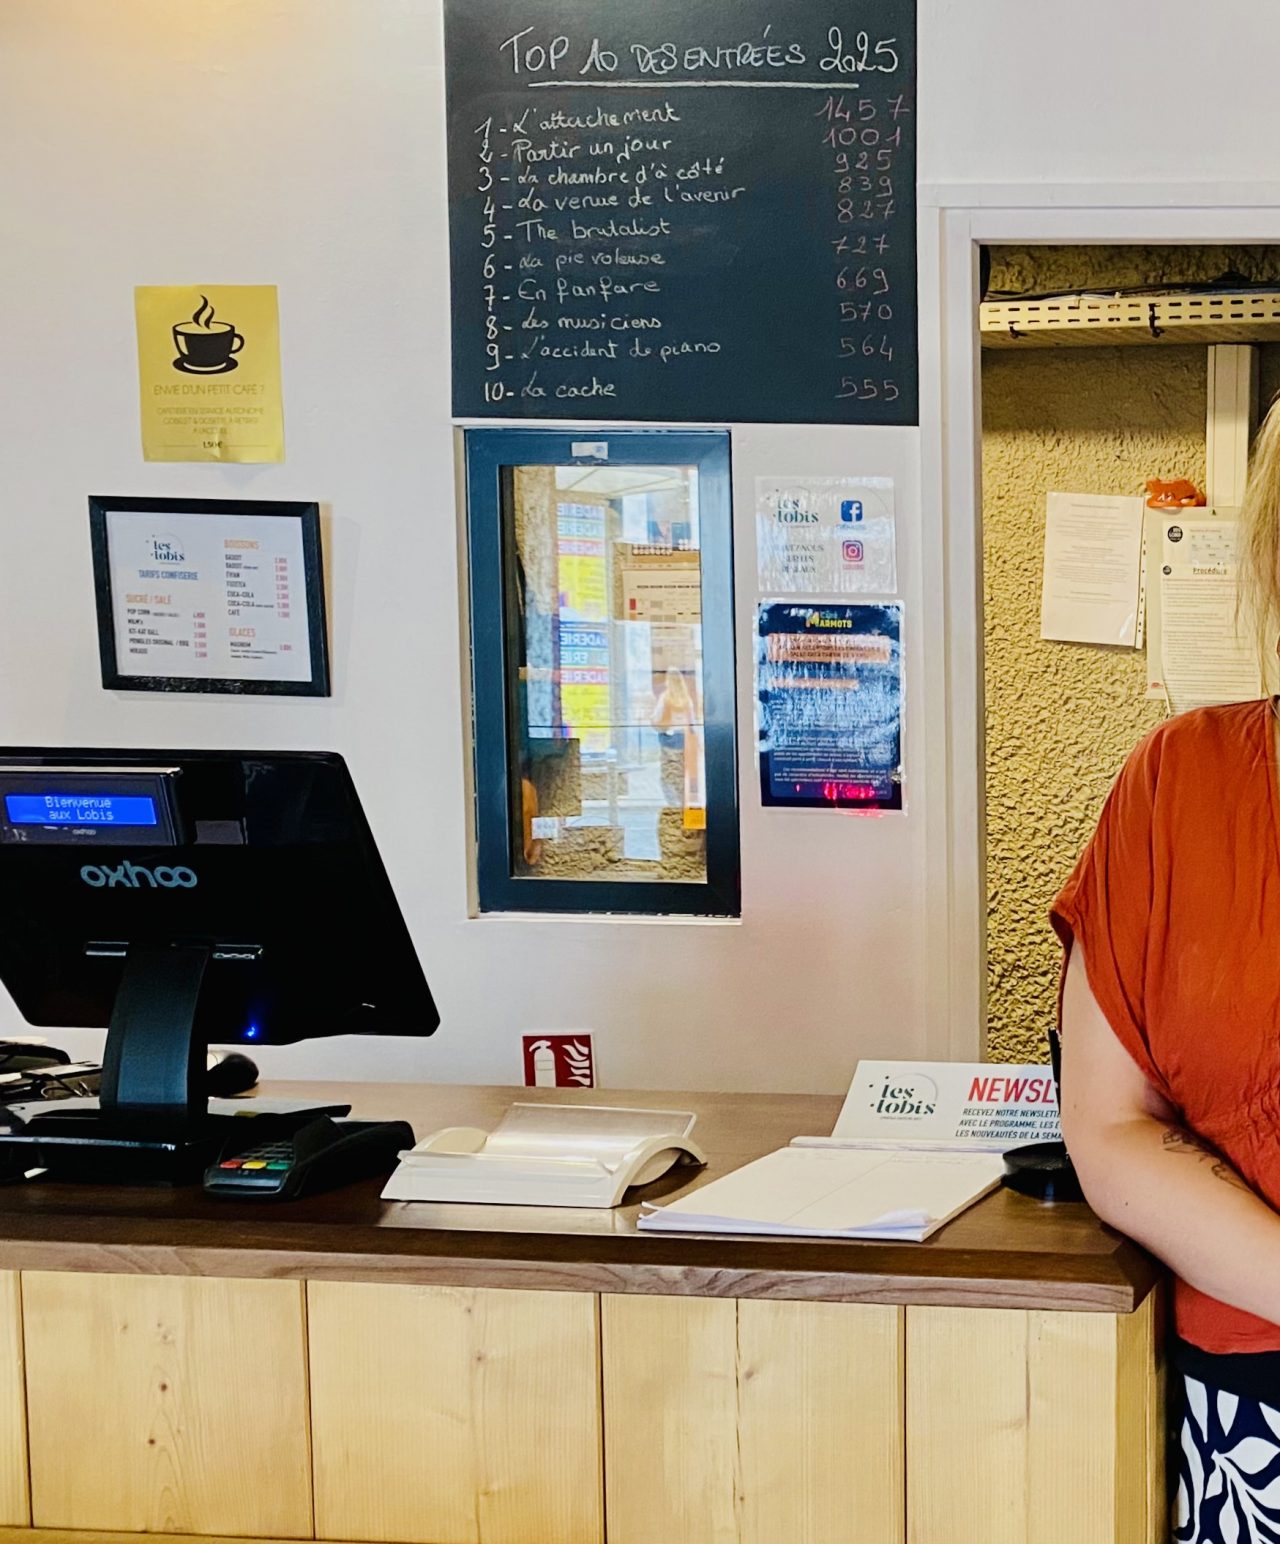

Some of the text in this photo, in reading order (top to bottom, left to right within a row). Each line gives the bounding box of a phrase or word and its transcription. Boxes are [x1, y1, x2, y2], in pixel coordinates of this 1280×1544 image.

[499, 24, 899, 75] TOP 10 DES ENTRÉES 2025
[513, 102, 681, 135] L'attachement
[815, 94, 910, 123] 1457
[511, 138, 581, 163] Partir
[589, 142, 614, 156] un
[616, 136, 673, 164] jour
[822, 126, 901, 148] 1001
[517, 165, 538, 185] La
[548, 166, 629, 186] chambre
[635, 162, 668, 182] d'à
[676, 157, 724, 180] côté
[833, 149, 892, 173] 925
[518, 188, 548, 212] La
[555, 194, 619, 211] venue
[628, 186, 653, 207] de
[664, 183, 746, 203] l'avenir
[838, 176, 893, 198] 839
[515, 218, 558, 243] The
[571, 217, 671, 240] brutalist
[837, 198, 896, 223] 827
[518, 252, 544, 268] La
[555, 252, 584, 271] pie
[591, 248, 666, 266] voleuse
[830, 233, 890, 255] 727
[518, 278, 547, 301] En
[557, 276, 660, 304] fanfare
[837, 266, 889, 295] 669
[521, 306, 549, 330] Les
[557, 313, 662, 331] musiciens
[839, 301, 892, 322] 570
[520, 335, 619, 359] L'accident
[629, 337, 651, 357] de
[660, 341, 721, 363] piano
[838, 334, 893, 361] 564
[153, 384, 180, 395] ENVIE
[521, 371, 547, 397] La
[555, 377, 617, 398] cache
[835, 376, 899, 401] 555
[777, 510, 819, 523] lobis
[153, 540, 171, 551] les
[154, 550, 185, 561] lobis
[44, 796, 112, 808] Bienvenue
[49, 809, 115, 821] aux Lobis
[80, 860, 198, 888] oxhoo
[881, 1084, 915, 1099] les
[968, 1077, 1055, 1103] NEWSL
[876, 1099, 936, 1114] lobis
[962, 1108, 994, 1117] RECEVEZ
[995, 1108, 1019, 1117] NOTRE
[958, 1119, 978, 1127] AVEC
[979, 1119, 988, 1127] LE
[970, 1129, 1019, 1139] NOUVEAUTÉS
[1019, 1131, 1029, 1139] DE
[1030, 1131, 1040, 1139] LA
